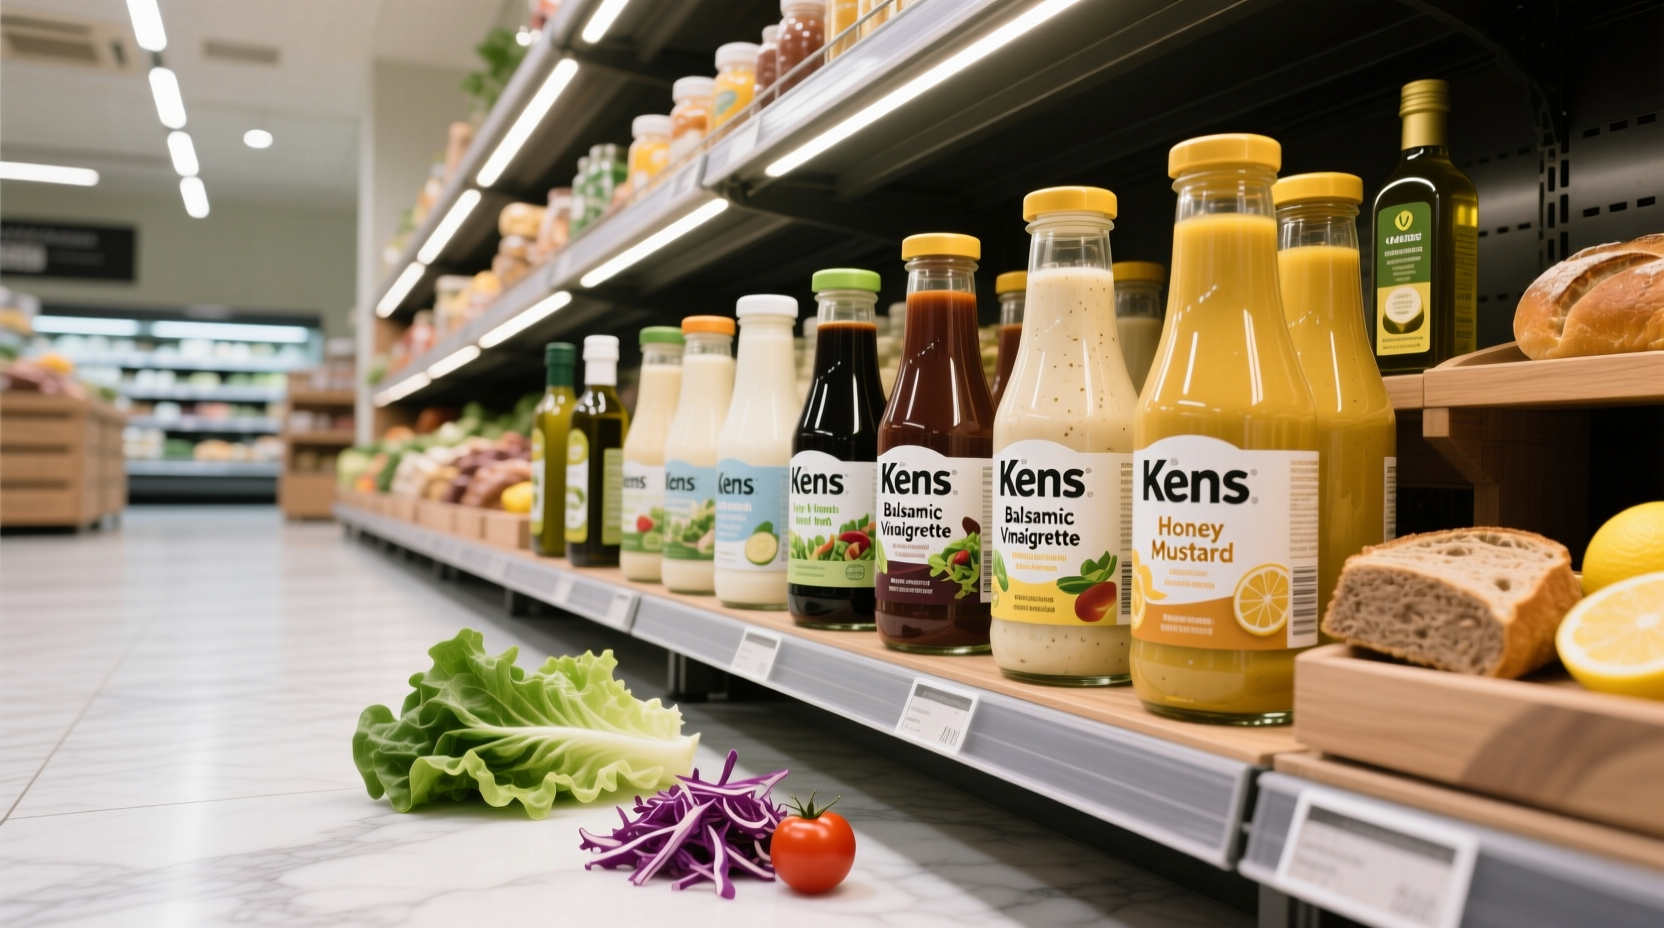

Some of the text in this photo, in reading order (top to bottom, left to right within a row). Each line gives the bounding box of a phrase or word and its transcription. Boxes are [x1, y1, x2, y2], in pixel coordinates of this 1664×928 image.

[791, 466, 844, 496] Kens
[881, 462, 952, 496] Kens
[1000, 459, 1086, 498] Kens
[1143, 459, 1250, 505] Kens
[1005, 505, 1075, 526] Balsamic
[1158, 515, 1224, 544] Honey
[1151, 539, 1234, 563] Mustard
